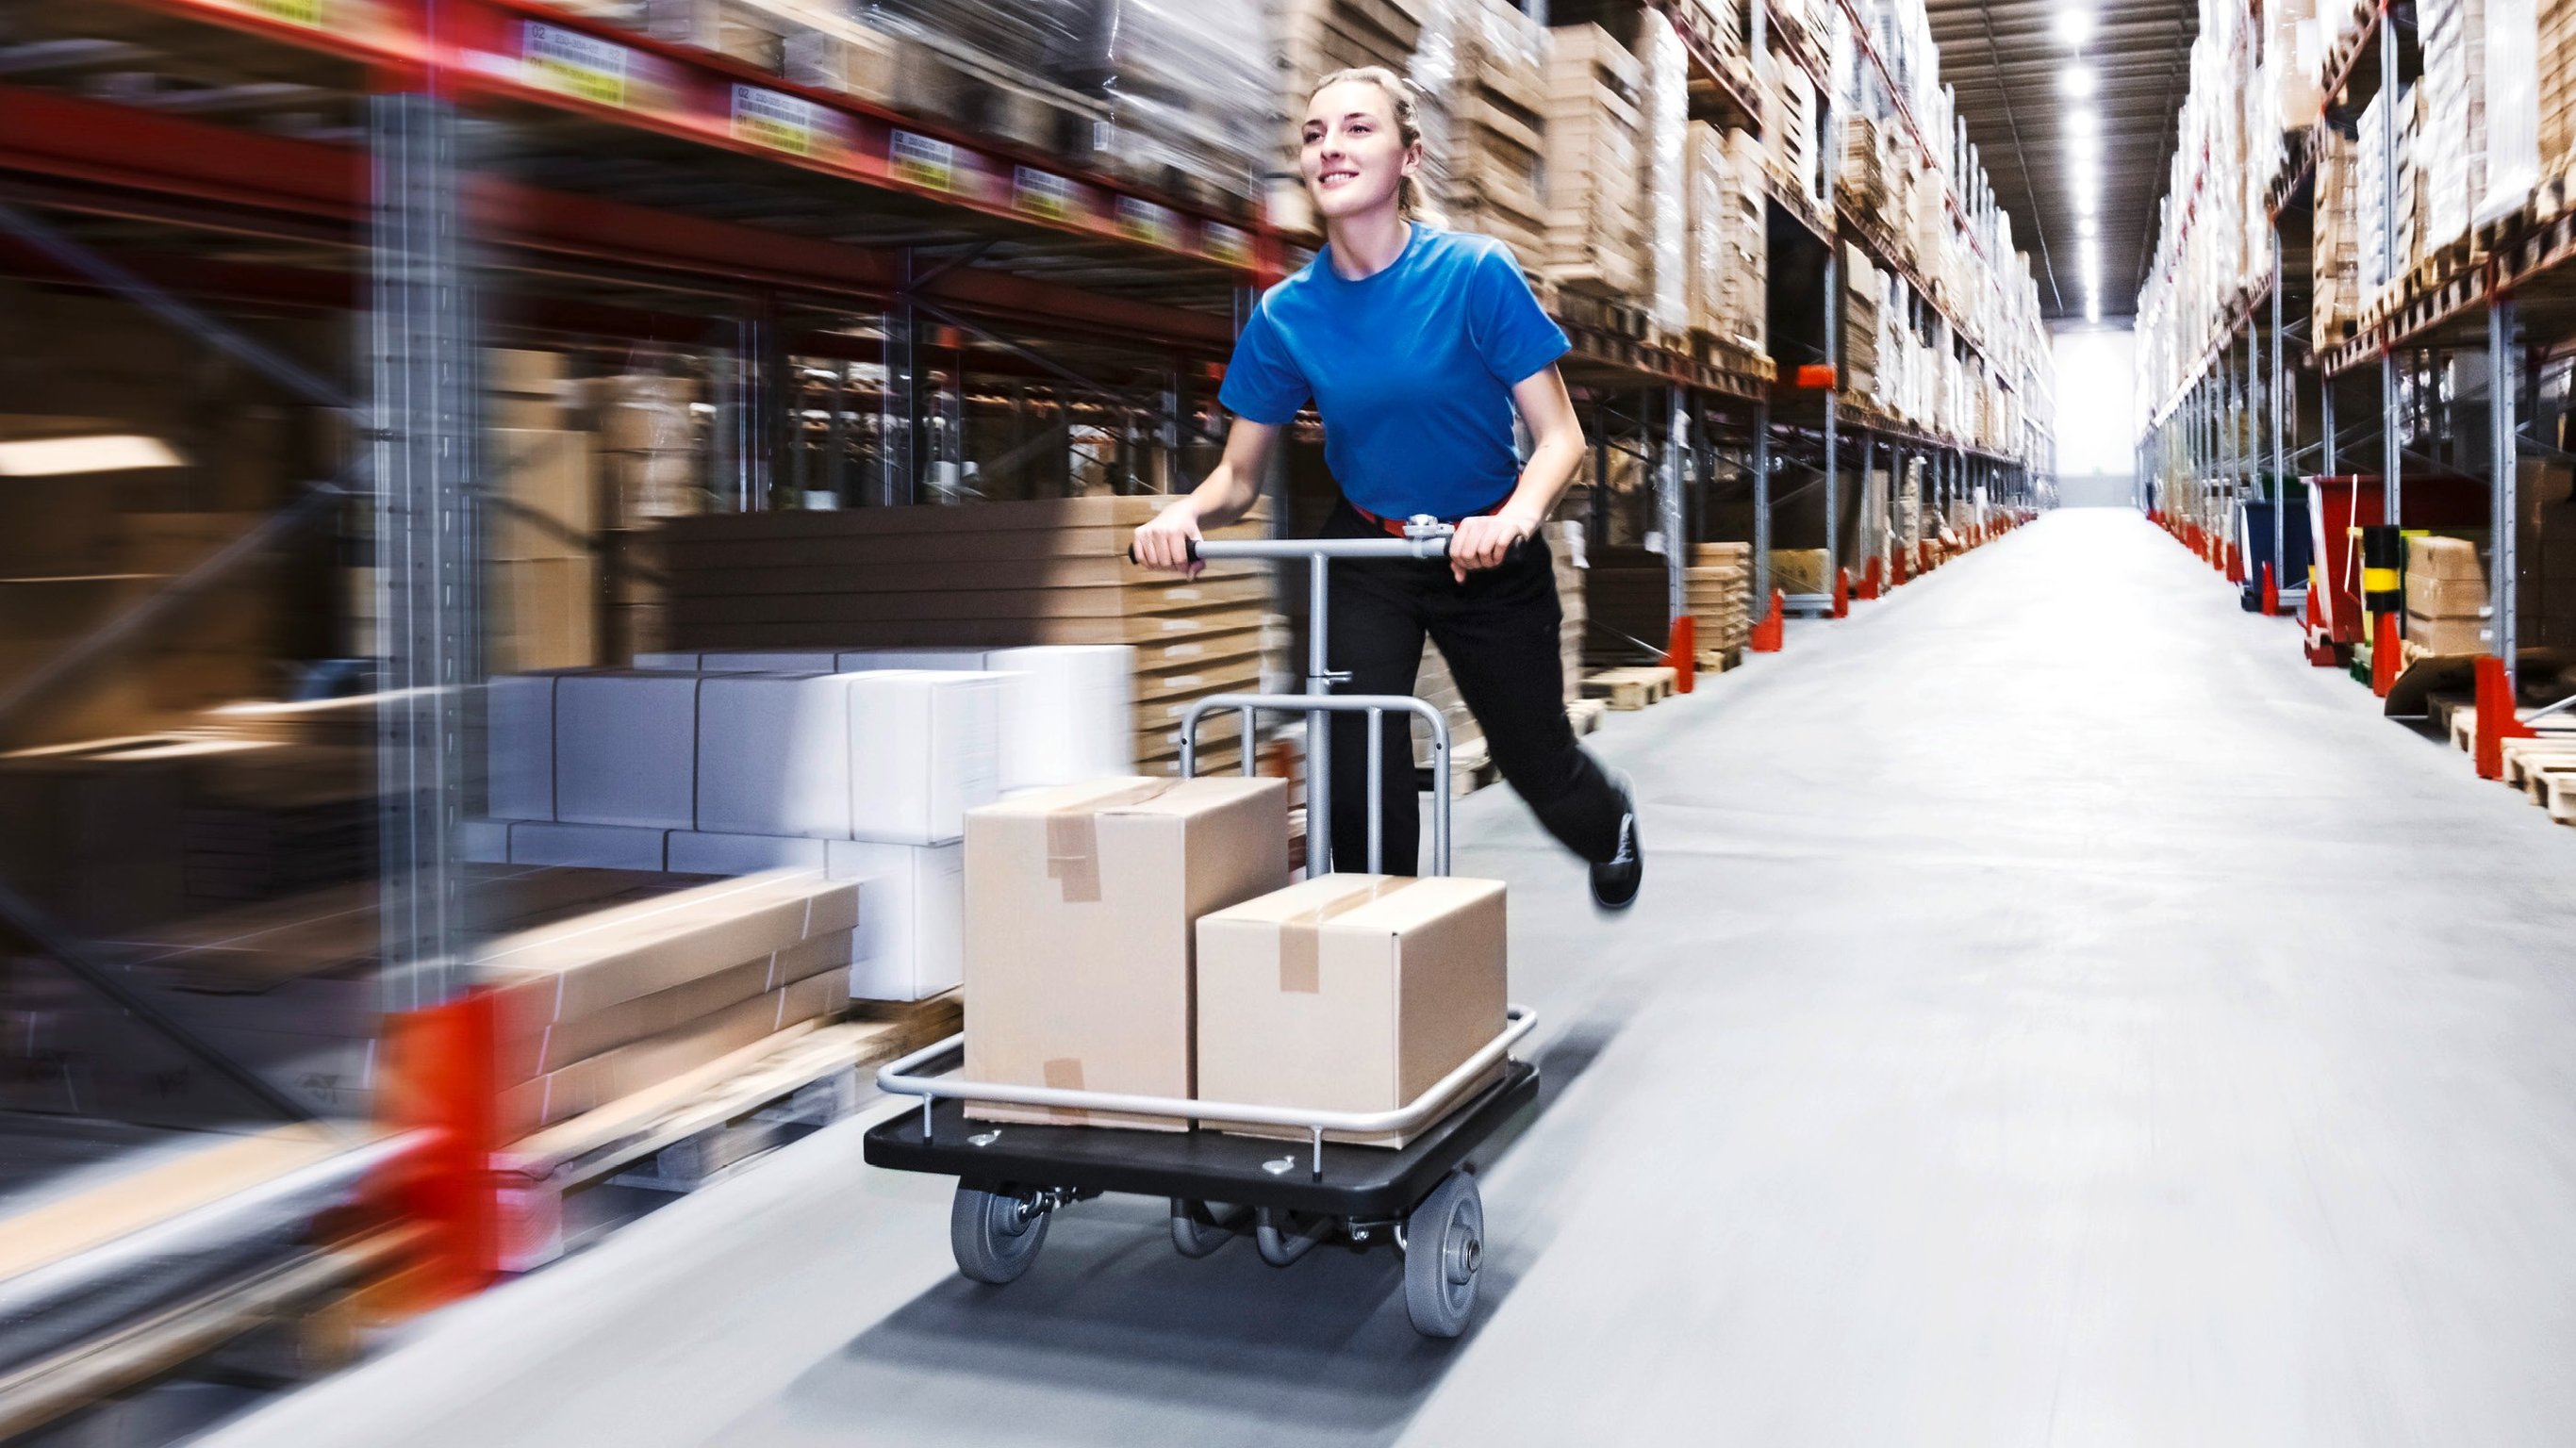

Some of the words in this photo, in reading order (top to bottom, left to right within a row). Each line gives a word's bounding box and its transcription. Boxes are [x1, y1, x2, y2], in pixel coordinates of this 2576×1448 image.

[532, 25, 545, 40] 02
[737, 87, 749, 99] 02
[737, 114, 747, 125] 01
